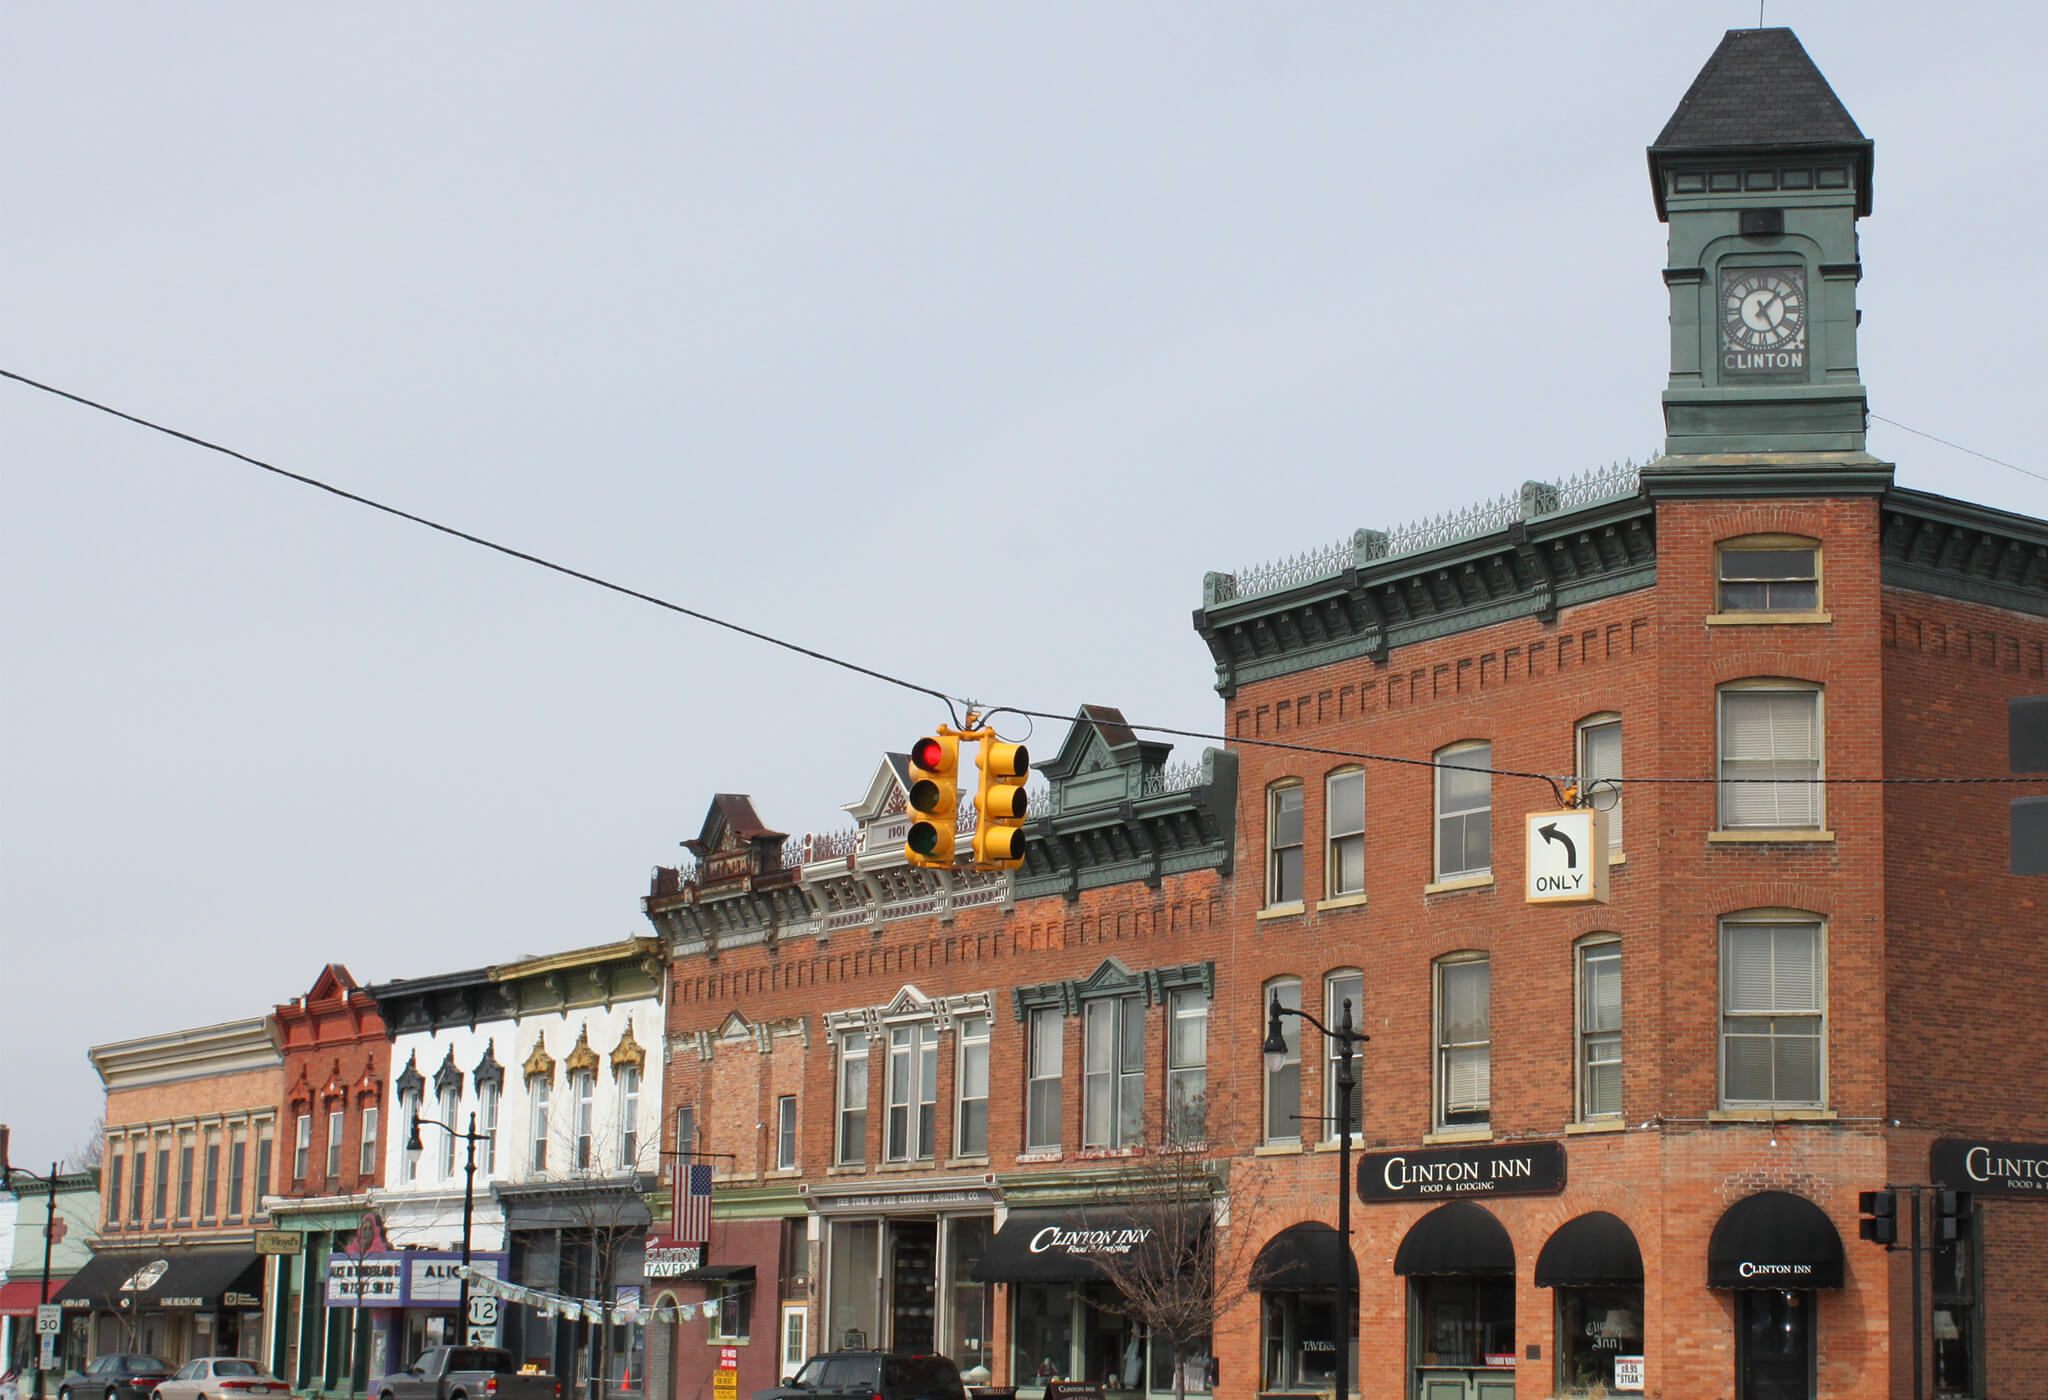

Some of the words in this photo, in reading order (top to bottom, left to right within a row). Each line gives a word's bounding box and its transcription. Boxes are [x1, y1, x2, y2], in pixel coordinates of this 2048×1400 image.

[1725, 353, 1803, 370] CLINTON
[1536, 874, 1584, 892] ONLY
[1384, 1157, 1479, 1190] CLINTON
[1491, 1158, 1532, 1178] INN
[1420, 1184, 1443, 1193] FOOD
[1446, 1184, 1452, 1192] &
[1456, 1181, 1494, 1191] LODGING
[2008, 1180, 2033, 1189] FOOD
[872, 1197, 881, 1205] OF
[899, 1194, 930, 1204] CENTURY
[933, 1192, 965, 1203] LIGHTING
[1030, 1226, 1118, 1254] CLINTON
[1116, 1228, 1152, 1243] INN
[645, 1247, 700, 1263] CLINTON
[424, 1265, 462, 1279] ALIC
[1739, 1261, 1791, 1278] CLINTON
[1794, 1265, 1812, 1274] INN
[472, 1302, 494, 1319] 12
[39, 1319, 58, 1330] 30
[1592, 1334, 1617, 1351] Inn
[1621, 1363, 1638, 1374] $9.95
